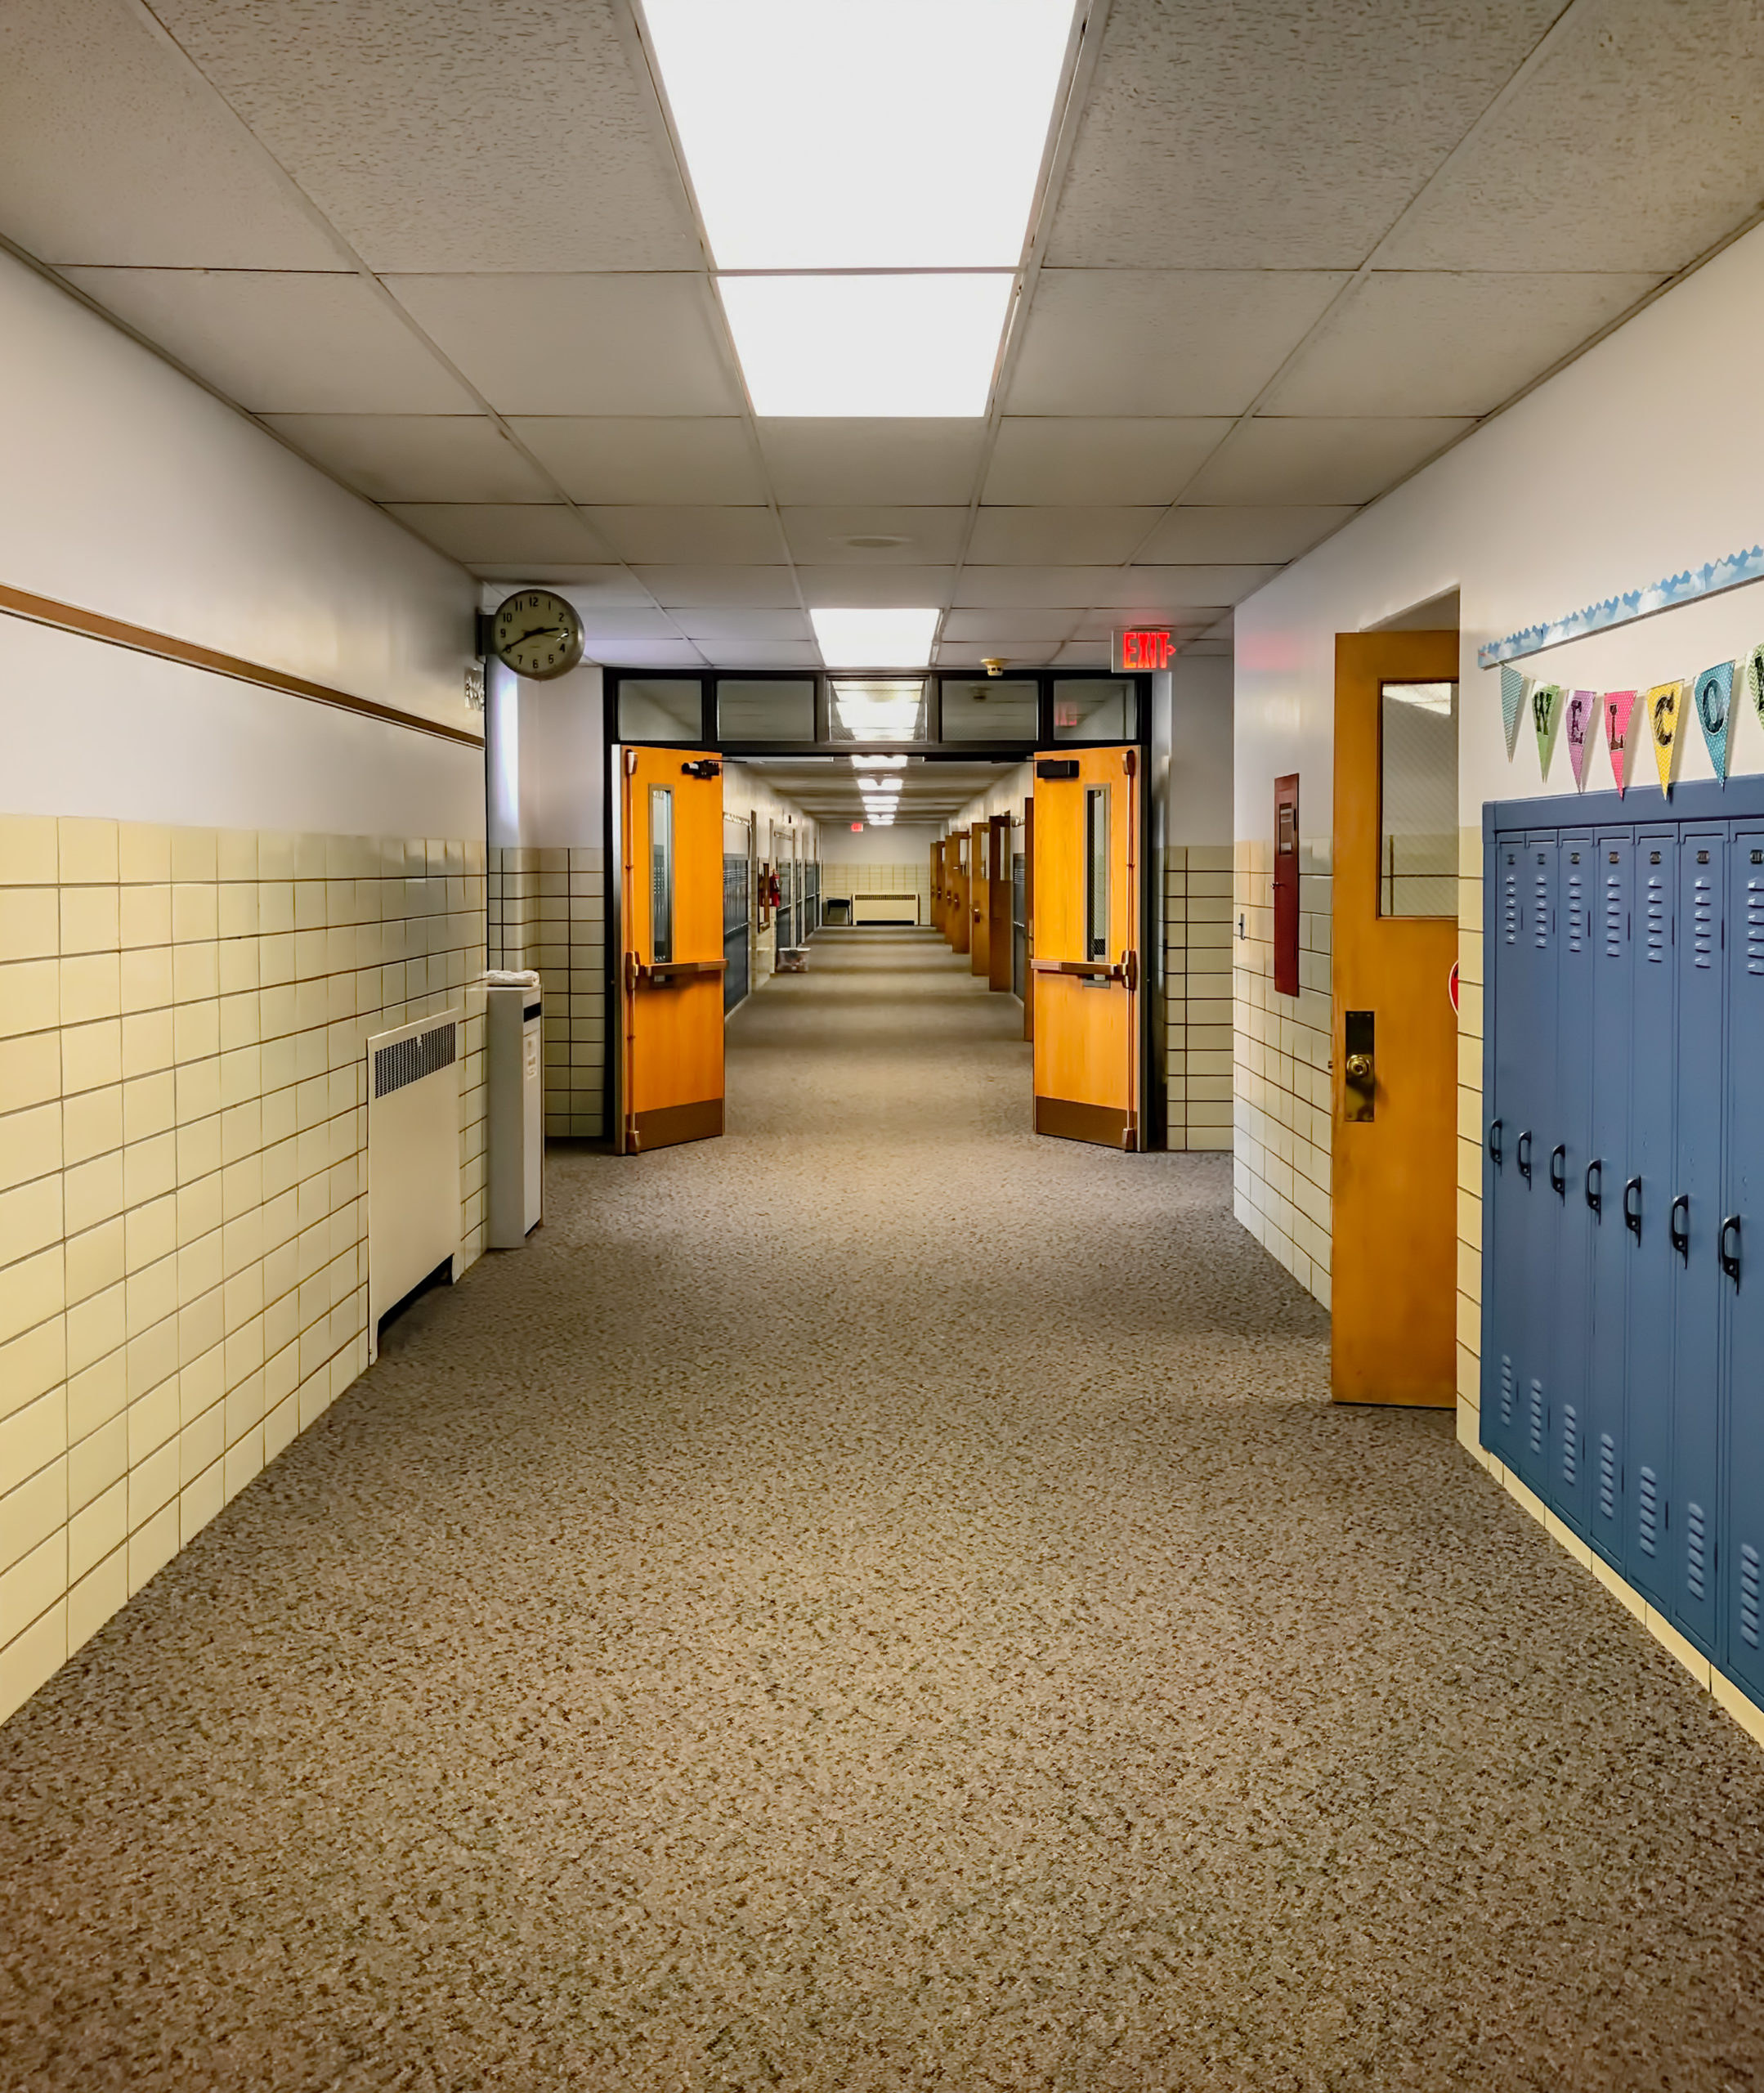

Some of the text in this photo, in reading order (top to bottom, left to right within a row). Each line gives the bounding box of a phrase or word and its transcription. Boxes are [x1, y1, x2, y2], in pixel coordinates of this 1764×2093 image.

[515, 601, 522, 612] 11
[529, 596, 539, 607] 12
[503, 612, 513, 623] 10
[558, 612, 564, 622] 2
[500, 628, 506, 638] 9
[559, 643, 566, 652] 4
[1123, 632, 1171, 670] EXIT
[517, 655, 522, 664] 7
[533, 659, 539, 669] 6
[548, 654, 554, 664] 5
